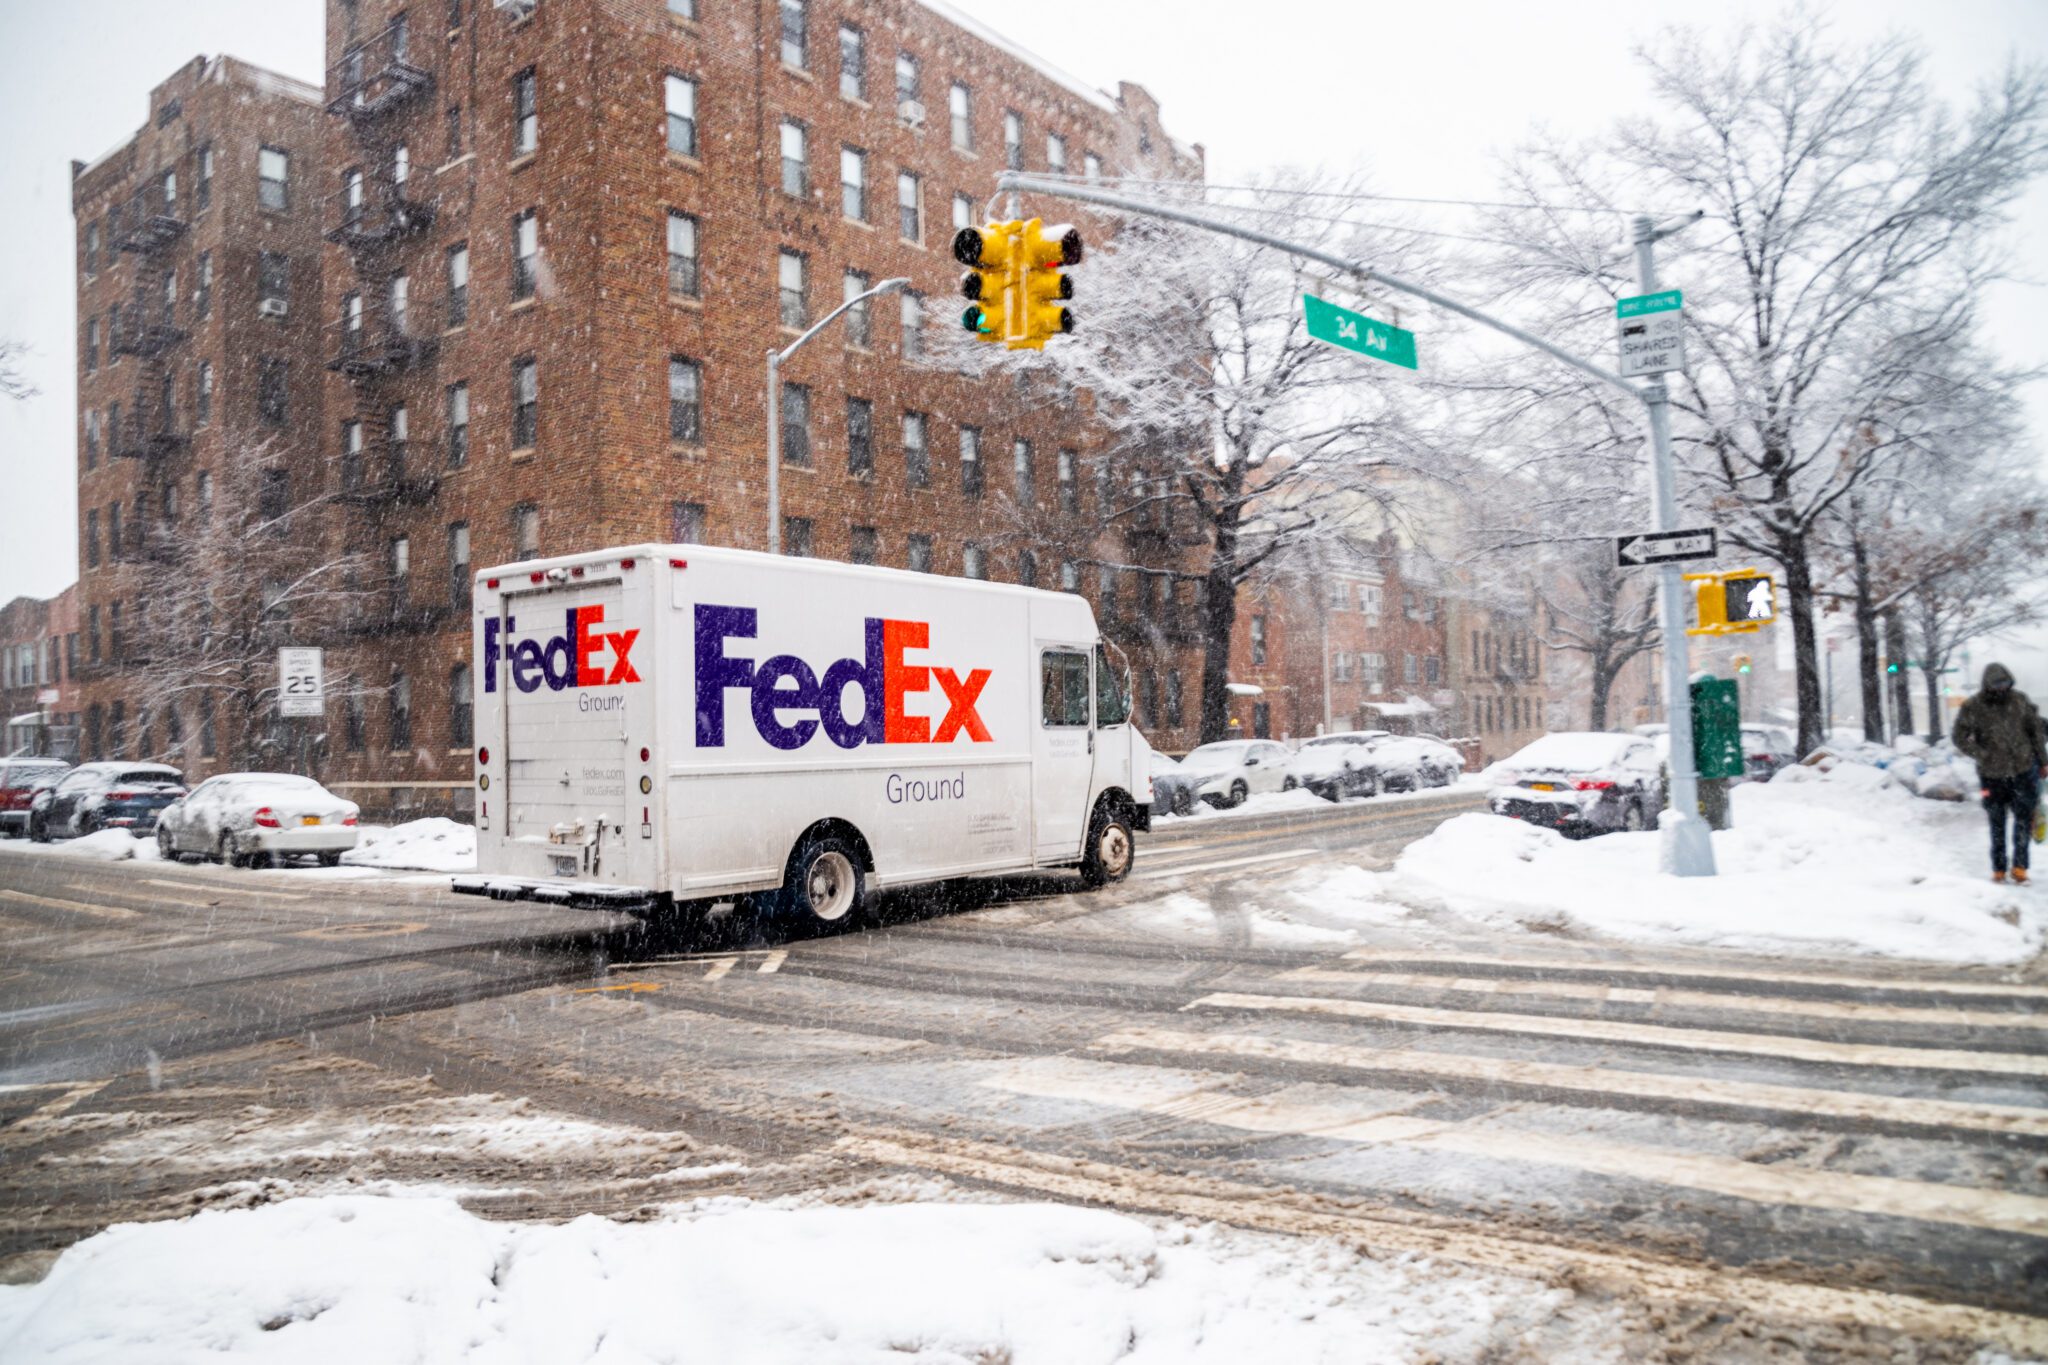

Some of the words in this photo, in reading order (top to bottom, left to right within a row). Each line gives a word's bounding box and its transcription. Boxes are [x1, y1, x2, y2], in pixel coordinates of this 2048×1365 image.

[1365, 327, 1387, 351] Av
[1623, 336, 1679, 354] SHARED
[1632, 353, 1669, 370] LANE
[1631, 543, 1659, 556] ONE
[1674, 539, 1703, 552] WAY
[485, 604, 641, 693] FedEx
[287, 675, 317, 693] 25
[695, 604, 993, 750] FedEx
[886, 771, 964, 804] Ground
